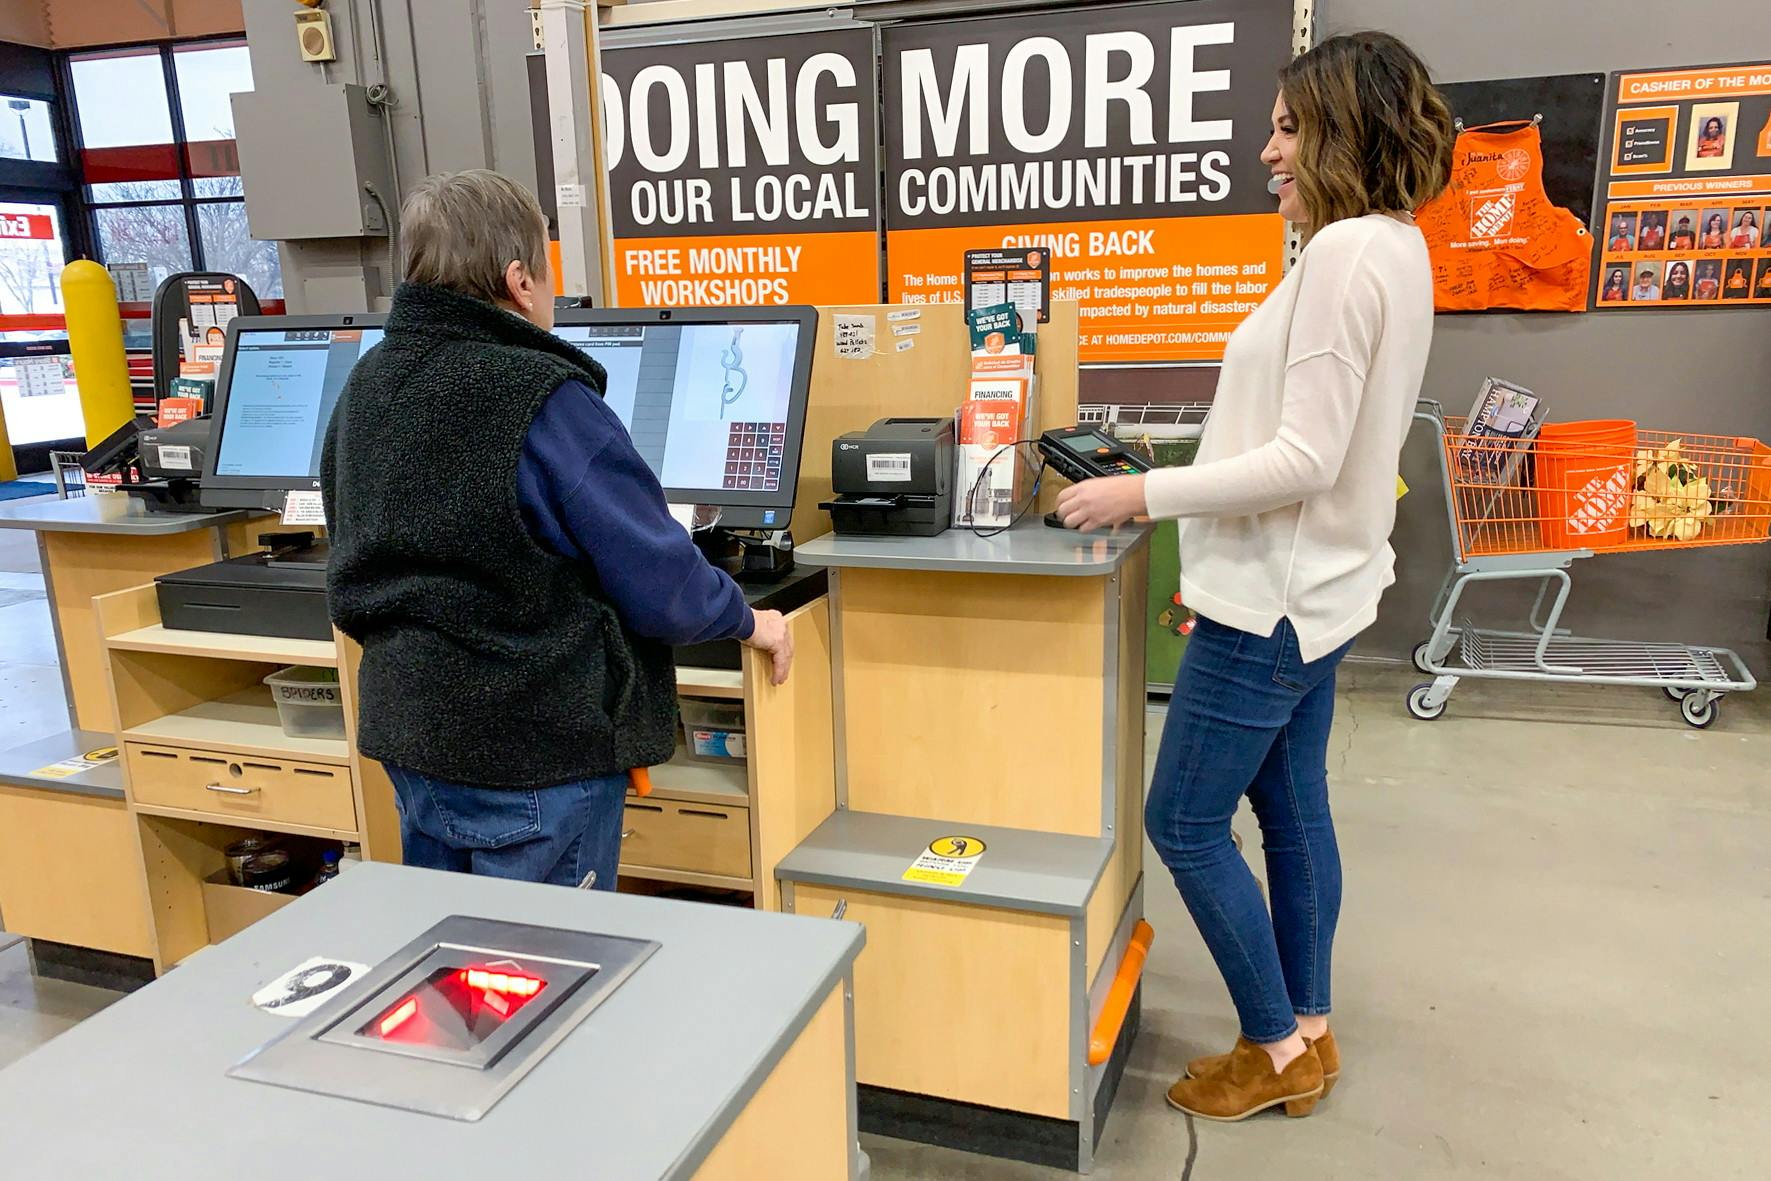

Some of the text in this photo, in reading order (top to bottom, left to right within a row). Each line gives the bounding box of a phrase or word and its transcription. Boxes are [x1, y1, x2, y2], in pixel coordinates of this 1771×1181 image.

[900, 22, 1235, 160] MORE
[1631, 74, 1771, 94] CASHIER OF THE MO
[1461, 152, 1505, 166] Juanita
[899, 150, 1232, 216] COMMUNITIES
[1653, 180, 1753, 192] PREVIOUS WINNERS
[630, 172, 870, 225] OUR LOCAL
[1471, 193, 1515, 237] HOME
[1475, 200, 1494, 218] THE
[1088, 229, 1155, 257] BACK
[625, 246, 802, 276] FREE MONTHLY
[904, 274, 923, 286] The
[926, 273, 958, 286] Home
[1064, 267, 1100, 281] works
[1104, 267, 1115, 280] to
[1119, 266, 1169, 282] improve
[1172, 264, 1192, 278] the
[1196, 263, 1238, 277] homes
[1242, 261, 1267, 276] and
[640, 278, 789, 306] WORKSHOPS
[902, 291, 925, 303] lives
[929, 291, 941, 303] of
[1052, 281, 1268, 302] skilled tradespeople to fill the labor
[976, 312, 1009, 325] WE'VE GOT
[1080, 300, 1259, 320] mpacted by natural disasters
[976, 320, 1011, 332] YOUR BACK
[1091, 334, 1103, 346] AT
[974, 390, 1013, 399] FINANCING
[1568, 465, 1627, 533] HOME
[1573, 476, 1605, 504] THE
[253, 876, 291, 891] SAMSUN
